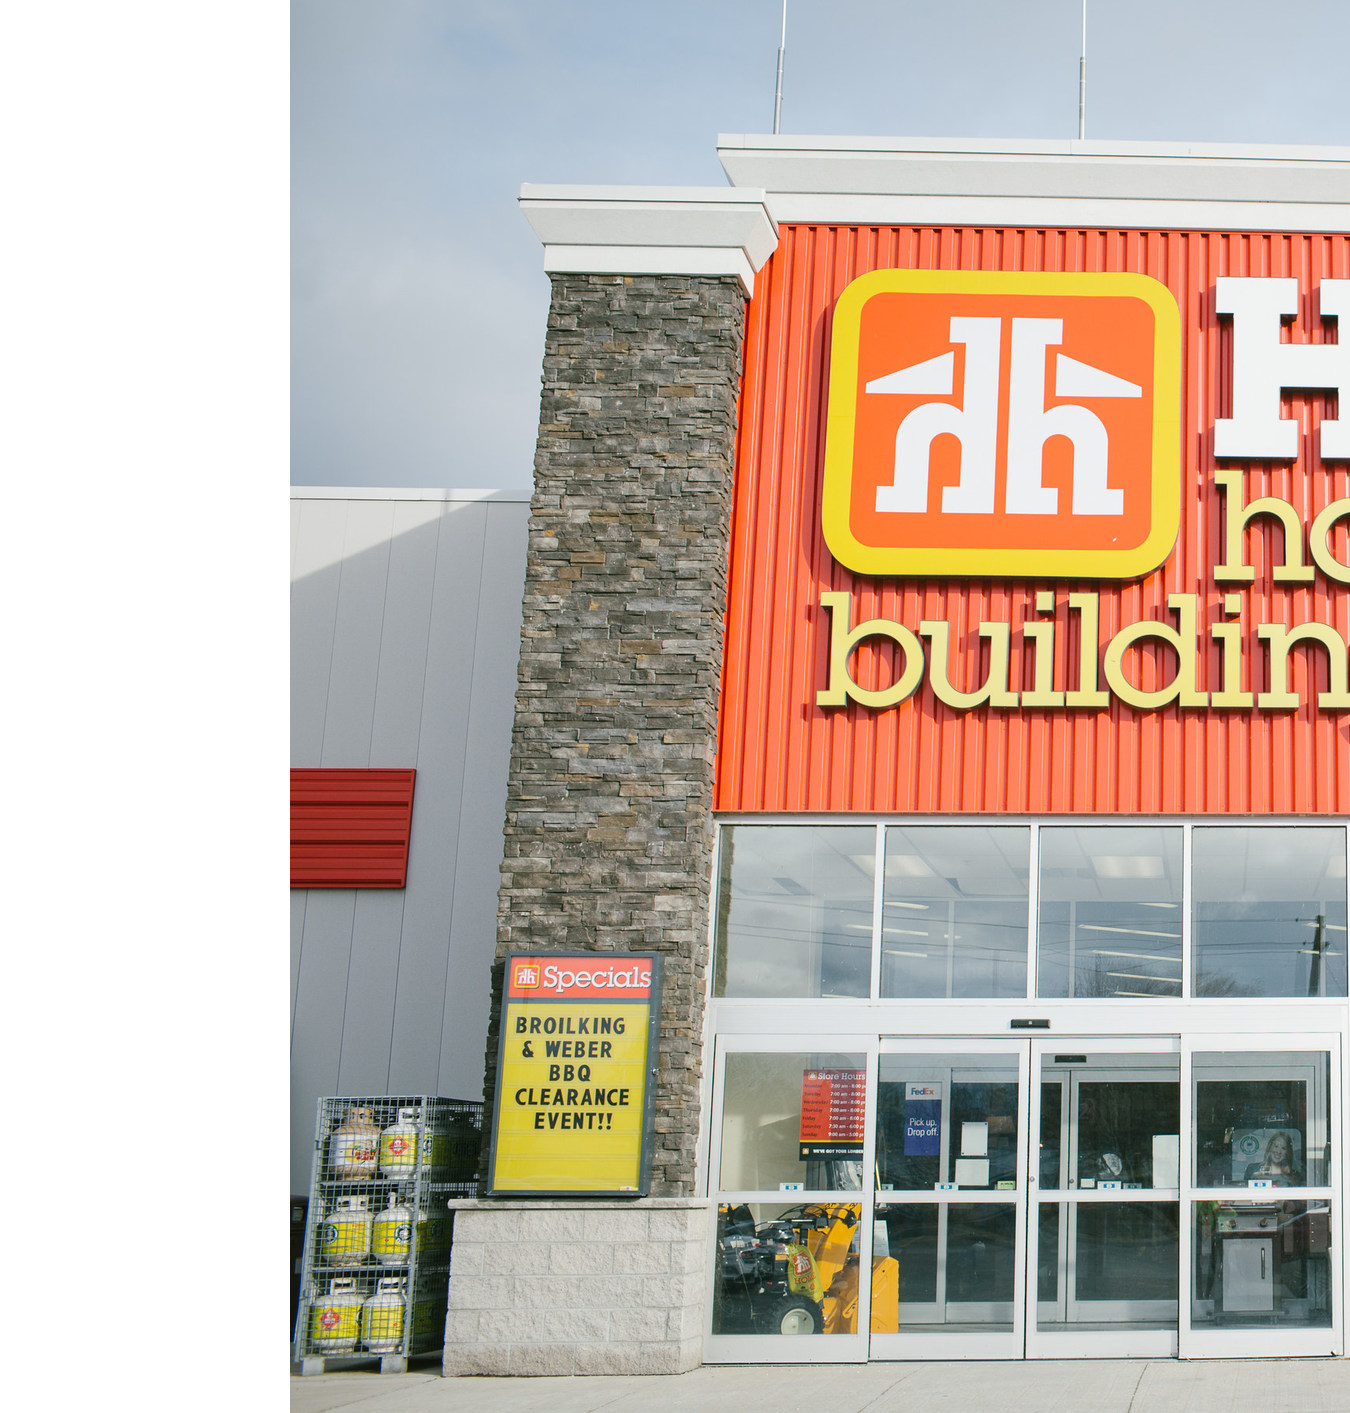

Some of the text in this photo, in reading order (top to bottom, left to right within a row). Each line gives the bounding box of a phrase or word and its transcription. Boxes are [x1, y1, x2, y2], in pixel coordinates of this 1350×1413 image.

[544, 966, 652, 993] Specials
[516, 1017, 625, 1034] BROILKING
[522, 1041, 612, 1058] & WEBER
[549, 1065, 591, 1081] BBQ
[818, 1072, 866, 1080] Store Hours
[515, 1088, 629, 1106] CLEARANCE
[534, 1112, 613, 1130] EVENT!!
[909, 1117, 937, 1127] Pick up.
[907, 1127, 939, 1138] Drop off.
